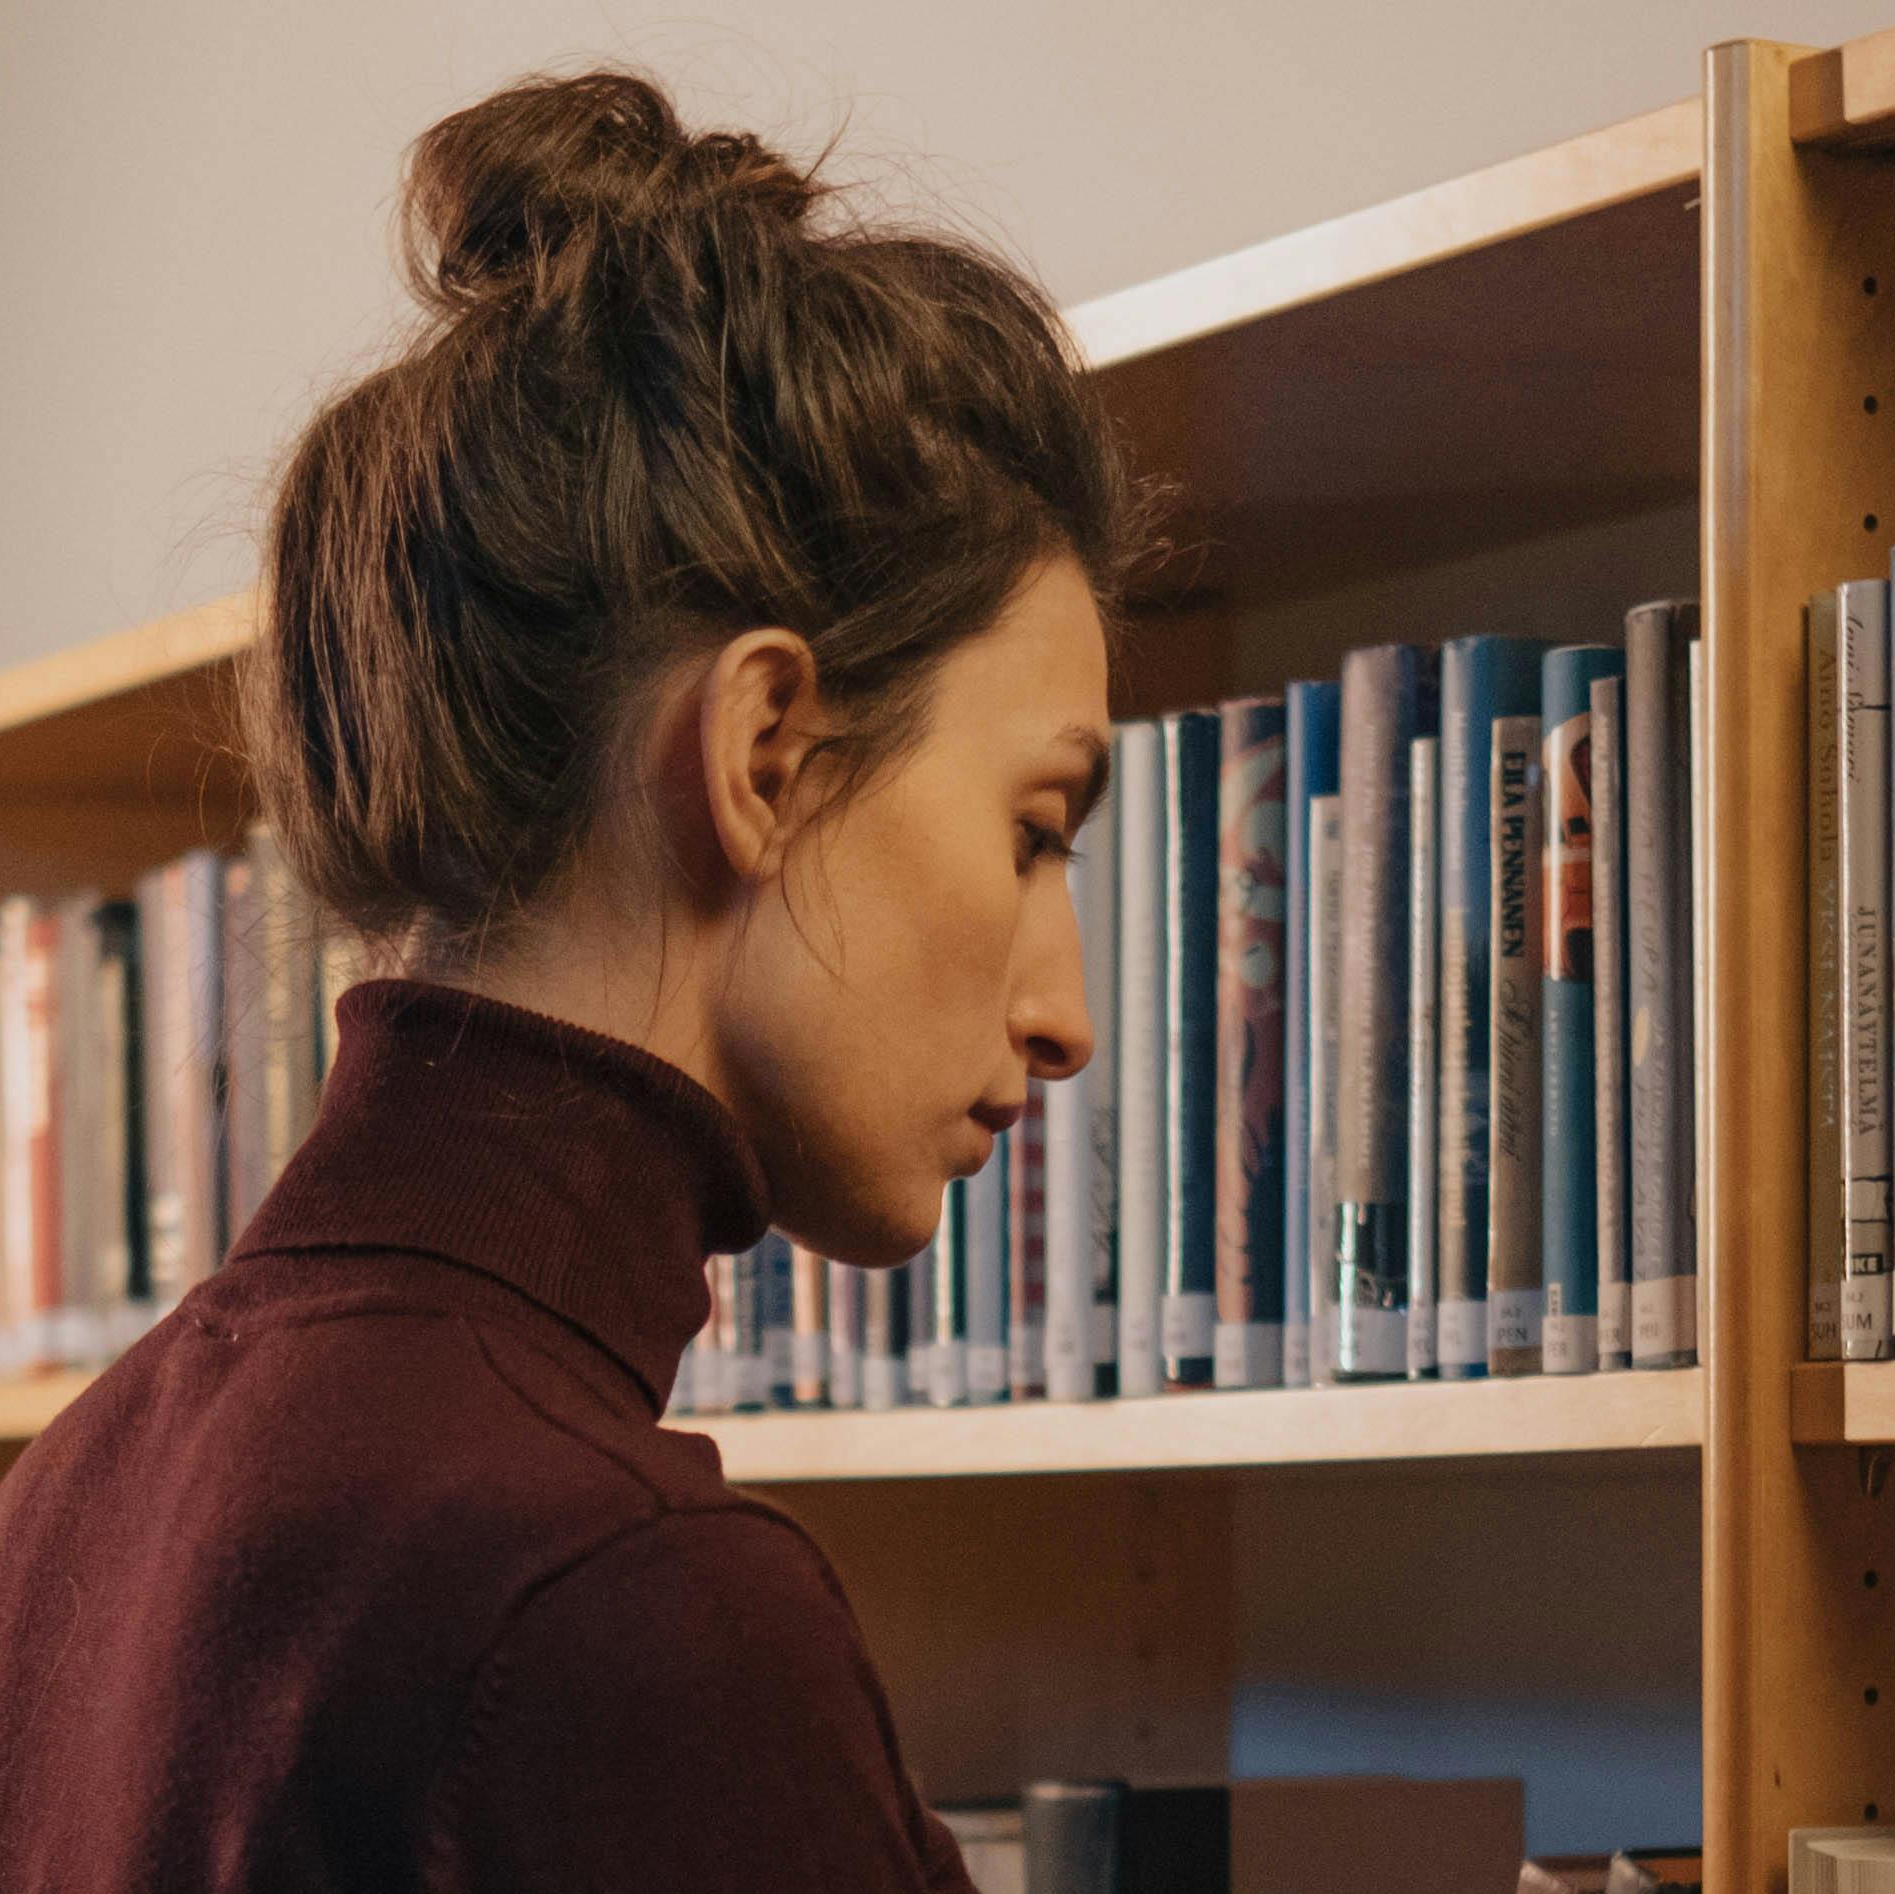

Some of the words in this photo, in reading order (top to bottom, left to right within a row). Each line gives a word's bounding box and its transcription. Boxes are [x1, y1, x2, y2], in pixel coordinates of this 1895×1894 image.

[1501, 751, 1525, 810] EILA
[1501, 816, 1525, 958] PENNANEN
[1856, 906, 1883, 1137] JUNANÄYTELMÄ
